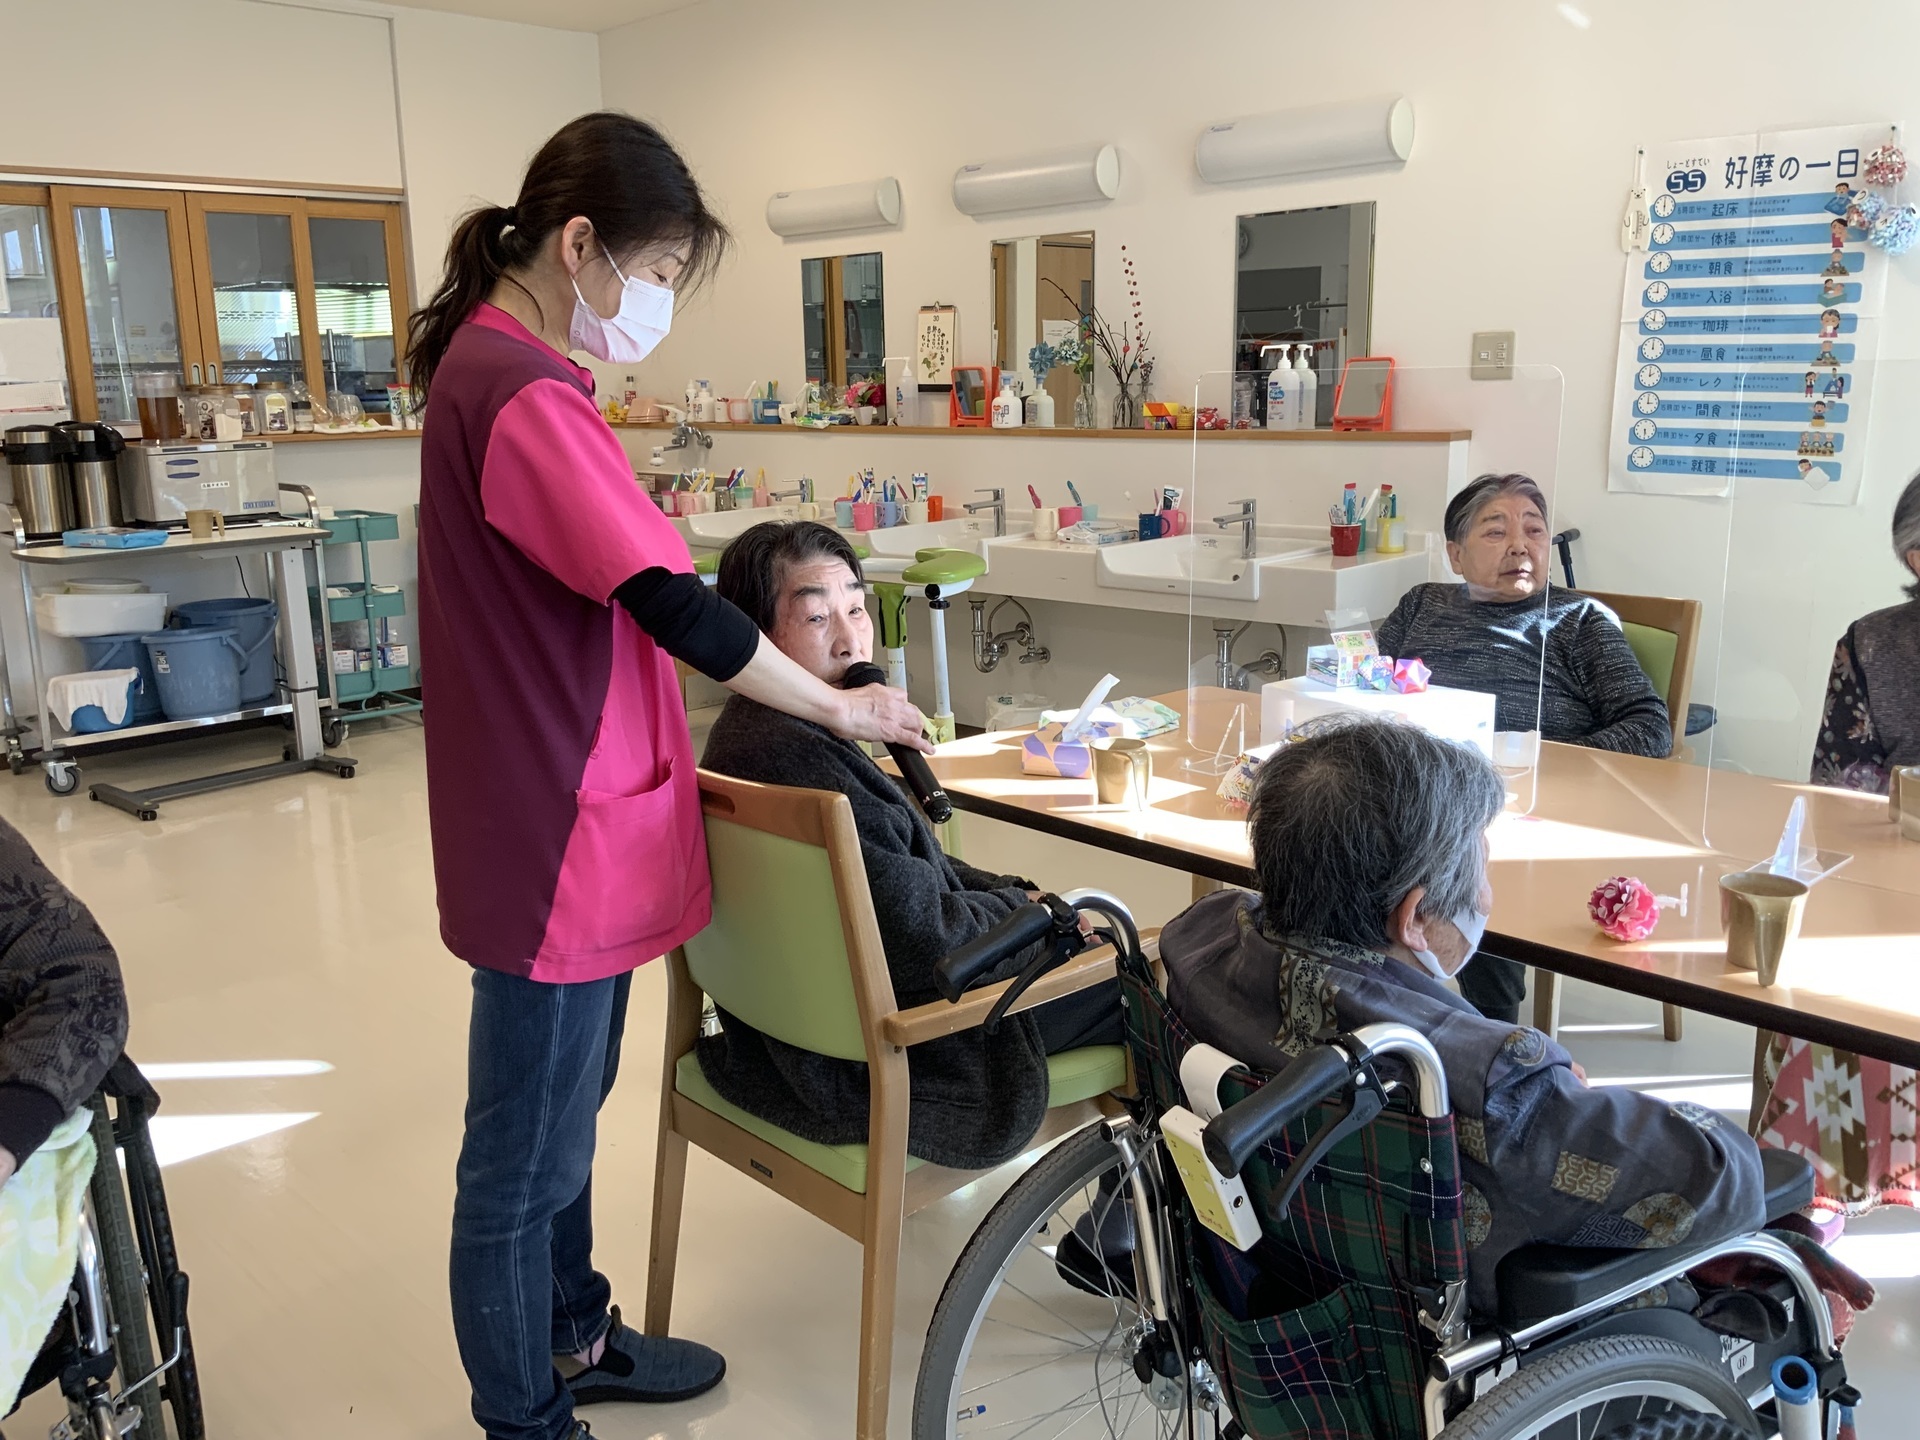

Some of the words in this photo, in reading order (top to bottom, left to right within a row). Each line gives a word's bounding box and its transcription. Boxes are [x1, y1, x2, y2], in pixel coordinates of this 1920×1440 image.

[1725, 148, 1860, 190] 好摩の一日
[1711, 201, 1739, 217] 起床
[1711, 231, 1737, 247] 体操
[1708, 260, 1733, 275] 朝食
[1705, 290, 1733, 304] 入浴
[1702, 319, 1729, 332] 珈琲
[1700, 347, 1726, 361] 昼食
[1699, 376, 1722, 388] レク
[1695, 403, 1722, 418] 間食
[1694, 431, 1718, 446] 夕食
[1690, 459, 1717, 473] 就寝
